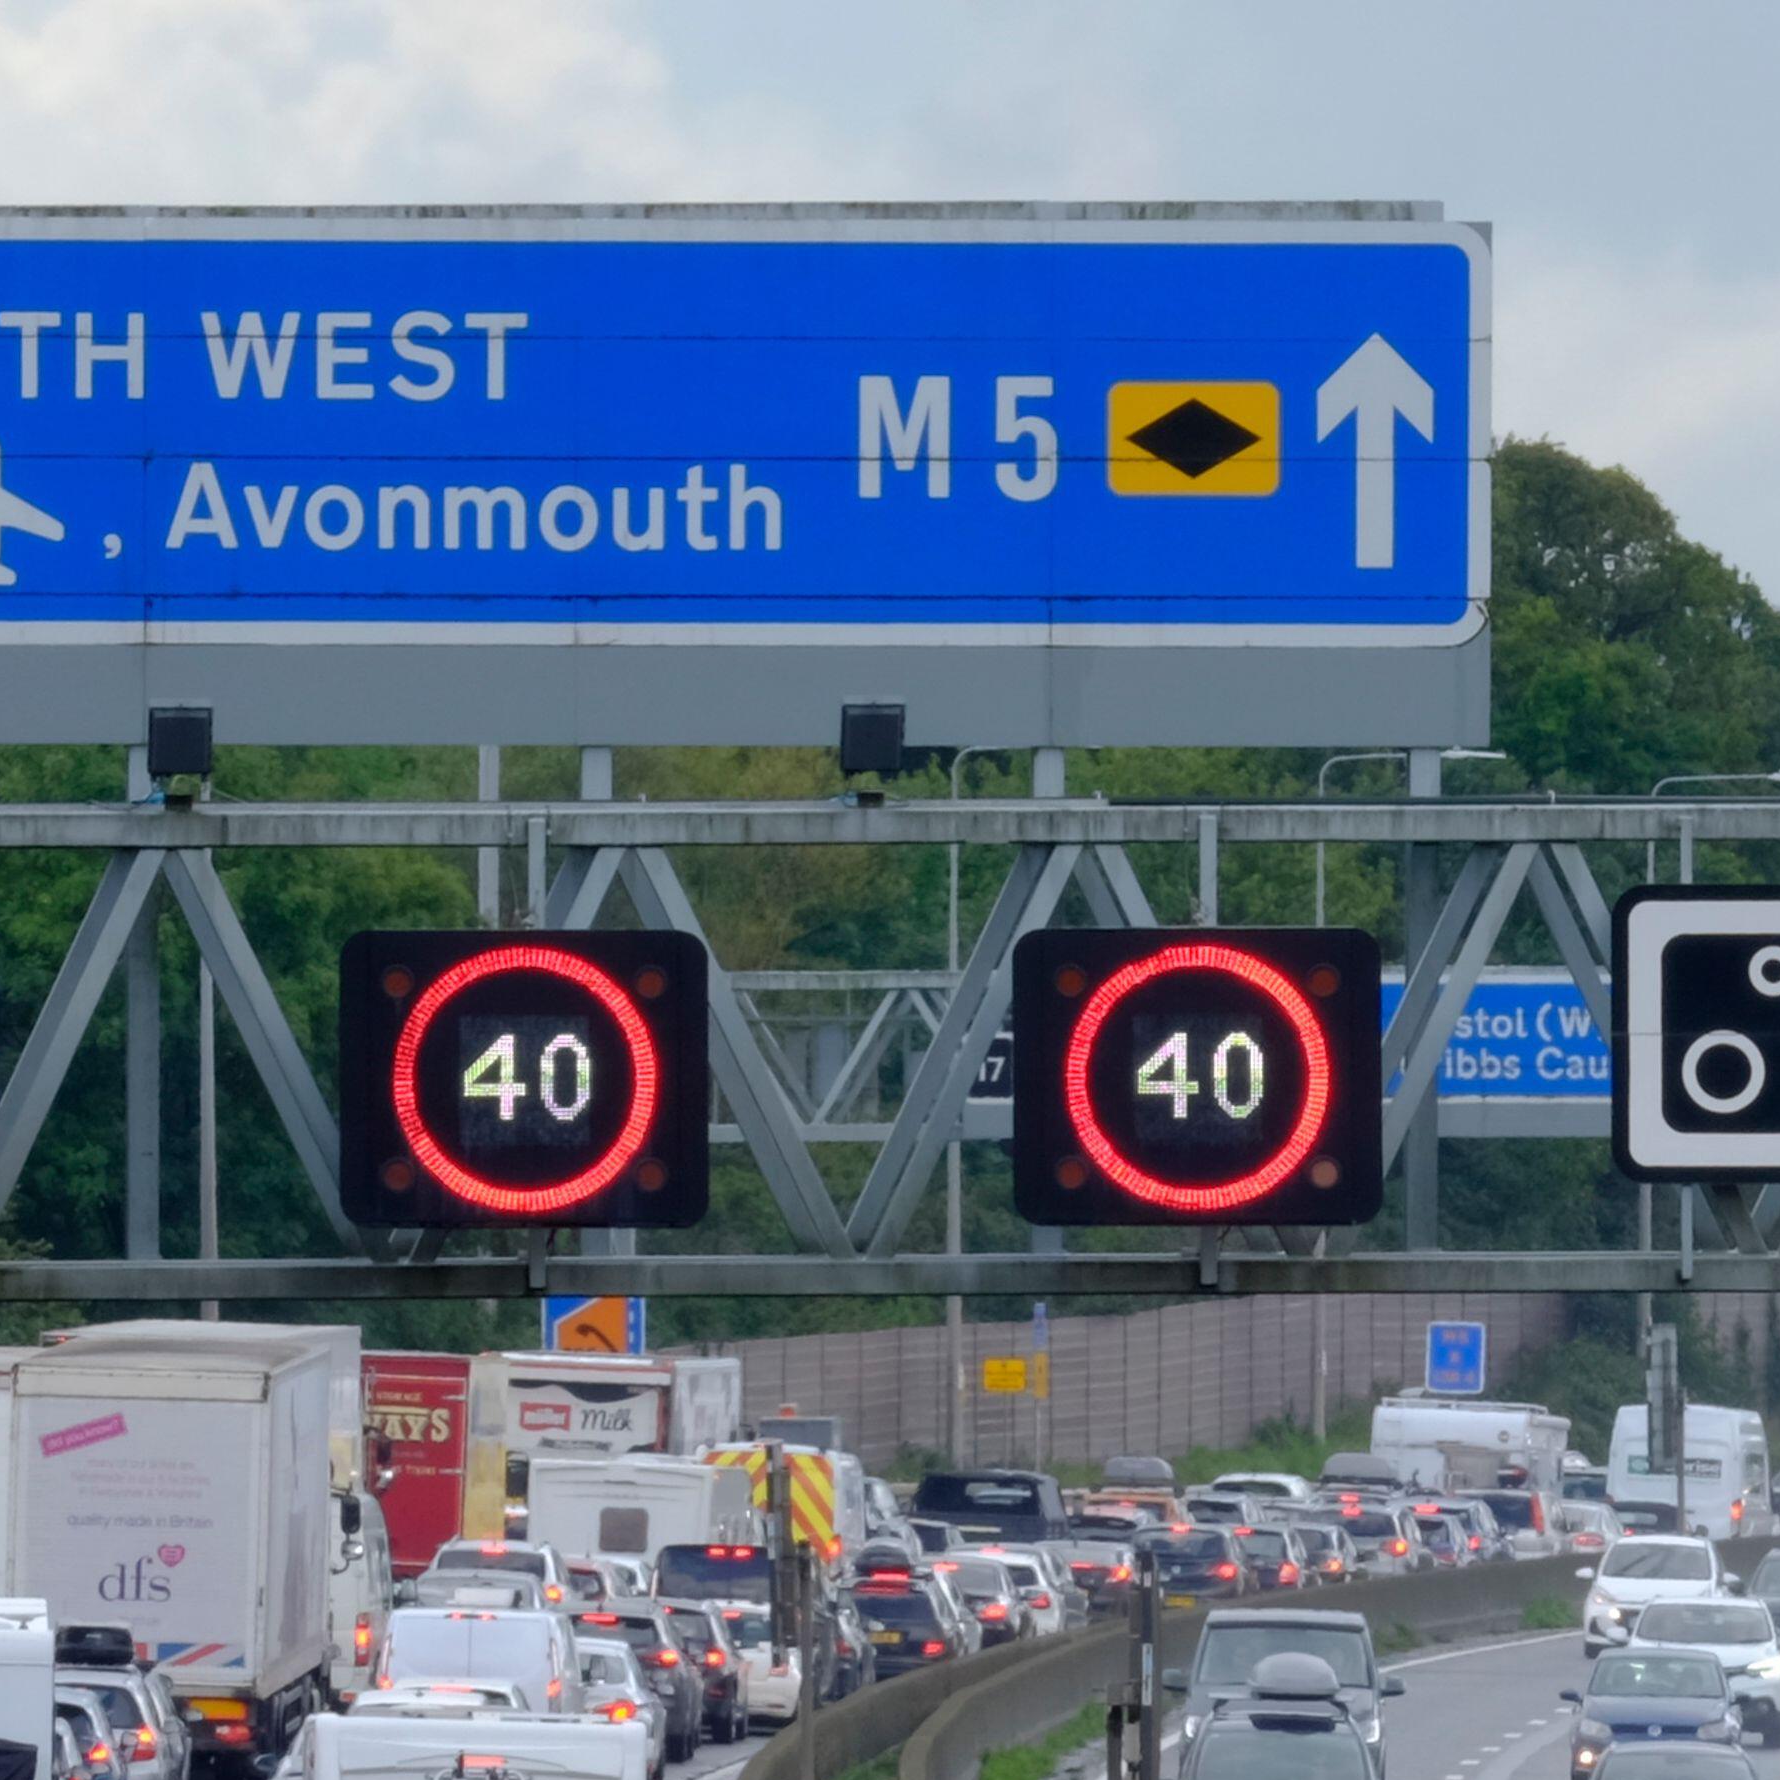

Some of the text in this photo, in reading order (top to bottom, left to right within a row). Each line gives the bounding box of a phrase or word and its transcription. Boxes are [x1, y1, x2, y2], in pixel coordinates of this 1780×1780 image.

[201, 311, 528, 401] WEST
[166, 462, 781, 551] Avonmouth
[1455, 1007, 1528, 1039] stol
[463, 1033, 592, 1122] 40
[1135, 1031, 1264, 1119] 40
[1444, 1046, 1609, 1080] ibbs Cau
[580, 1407, 633, 1431] Milk
[113, 1514, 152, 1527] made
[98, 1555, 171, 1603] dfs
